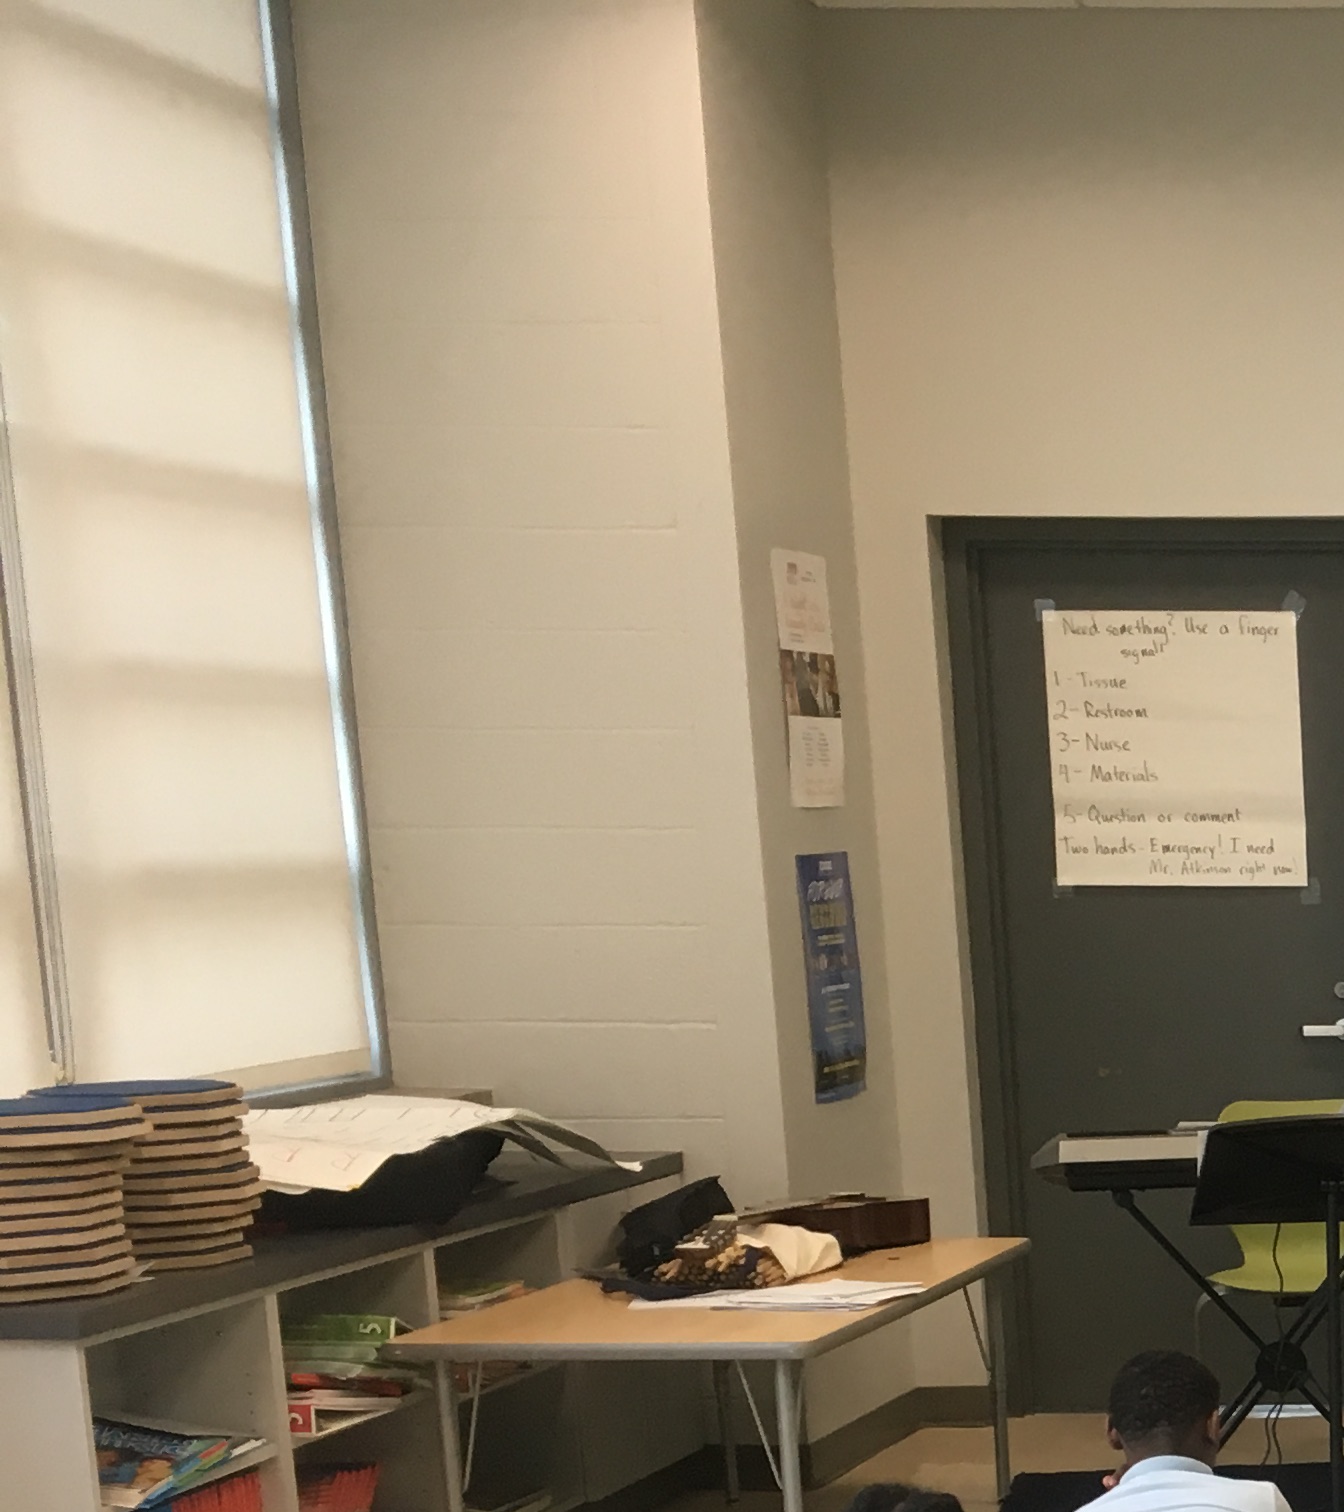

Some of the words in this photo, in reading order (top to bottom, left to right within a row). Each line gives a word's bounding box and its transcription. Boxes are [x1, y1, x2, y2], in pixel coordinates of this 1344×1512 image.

[1062, 616, 1100, 637] Need
[1105, 613, 1176, 644] something?
[1185, 617, 1208, 635] Use
[1219, 623, 1229, 634] a
[1239, 614, 1280, 643] finger
[1076, 671, 1127, 689] Tissue
[1084, 701, 1149, 719] Restroom
[1085, 732, 1131, 751] Nurse
[1090, 760, 1158, 783] Materials
[1088, 804, 1146, 825] Question
[1157, 812, 1172, 823] or
[1184, 808, 1242, 823] comment
[1058, 836, 1089, 855] Two
[1094, 836, 1136, 855] hands
[1230, 837, 1240, 855] I
[1247, 837, 1275, 855] need
[1150, 859, 1173, 875] Mr.
[1181, 860, 1231, 875] Atkinson
[1239, 861, 1265, 880] right
